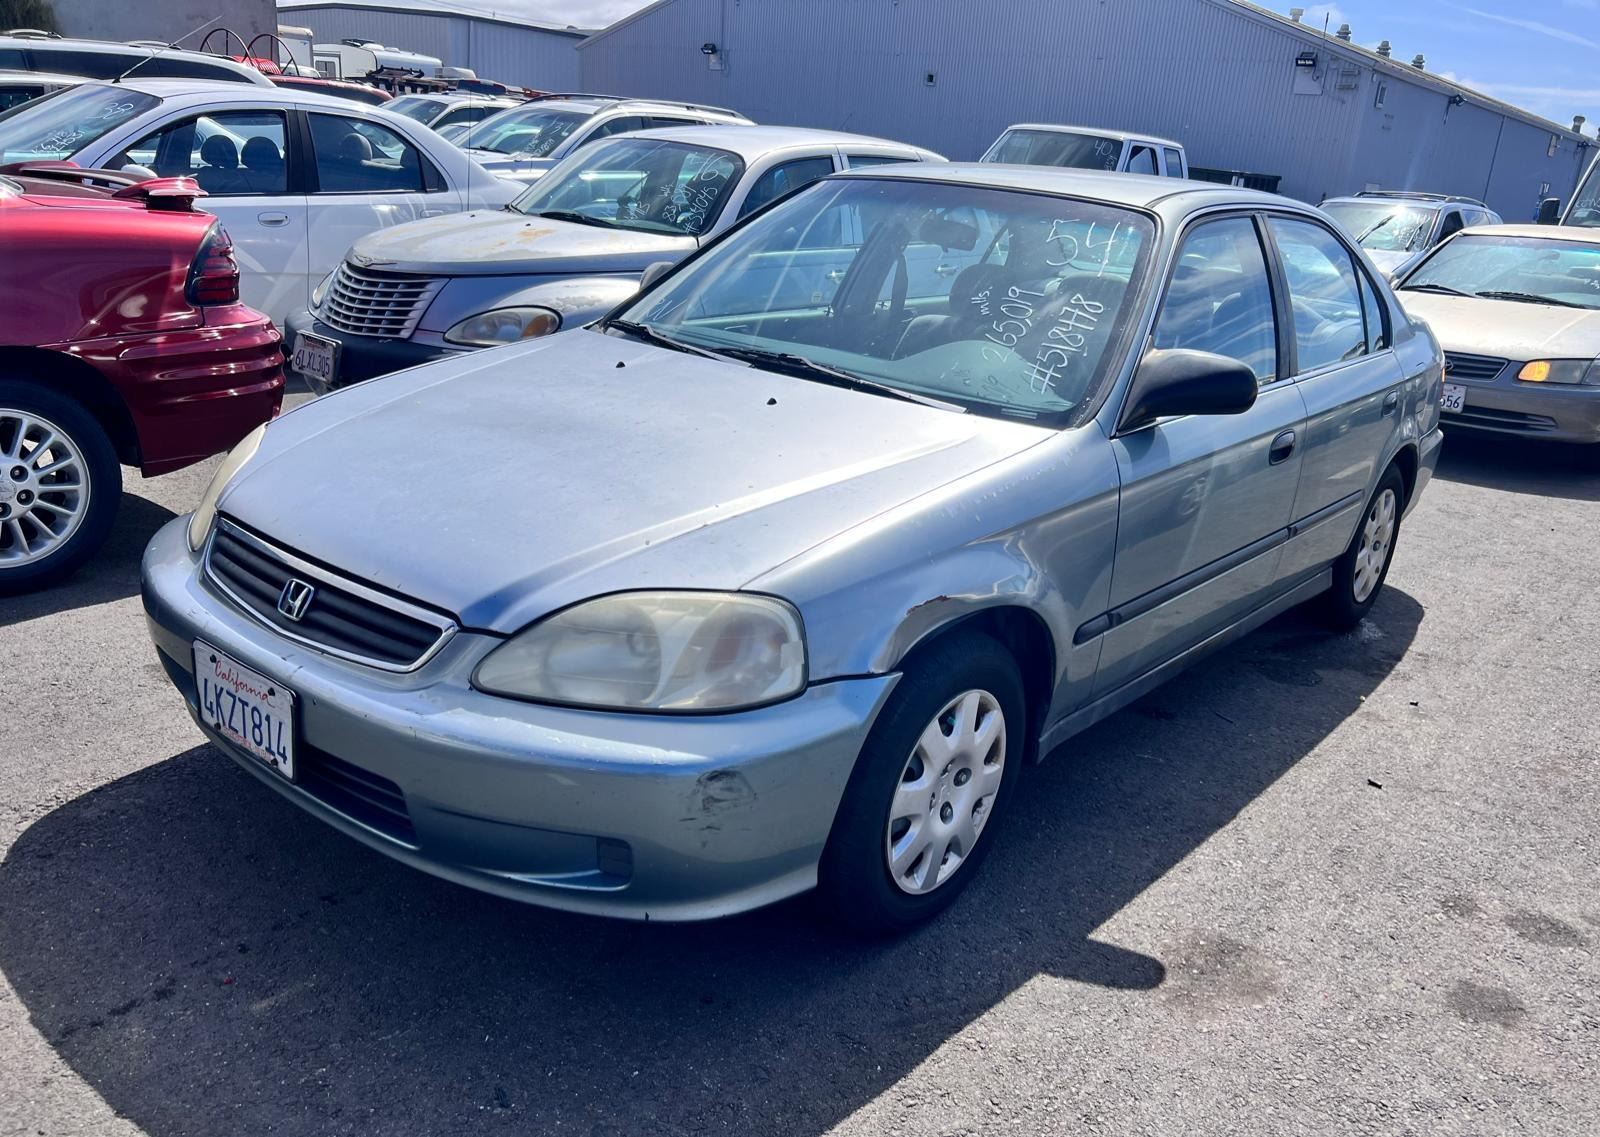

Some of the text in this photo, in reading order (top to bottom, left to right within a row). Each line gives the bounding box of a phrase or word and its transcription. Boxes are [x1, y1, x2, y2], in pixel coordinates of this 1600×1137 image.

[1094, 139, 1113, 156] 40
[1045, 218, 1120, 278] 54
[1023, 293, 1104, 395] #518478
[214, 659, 277, 709] California
[203, 677, 288, 766] 4KZT814
